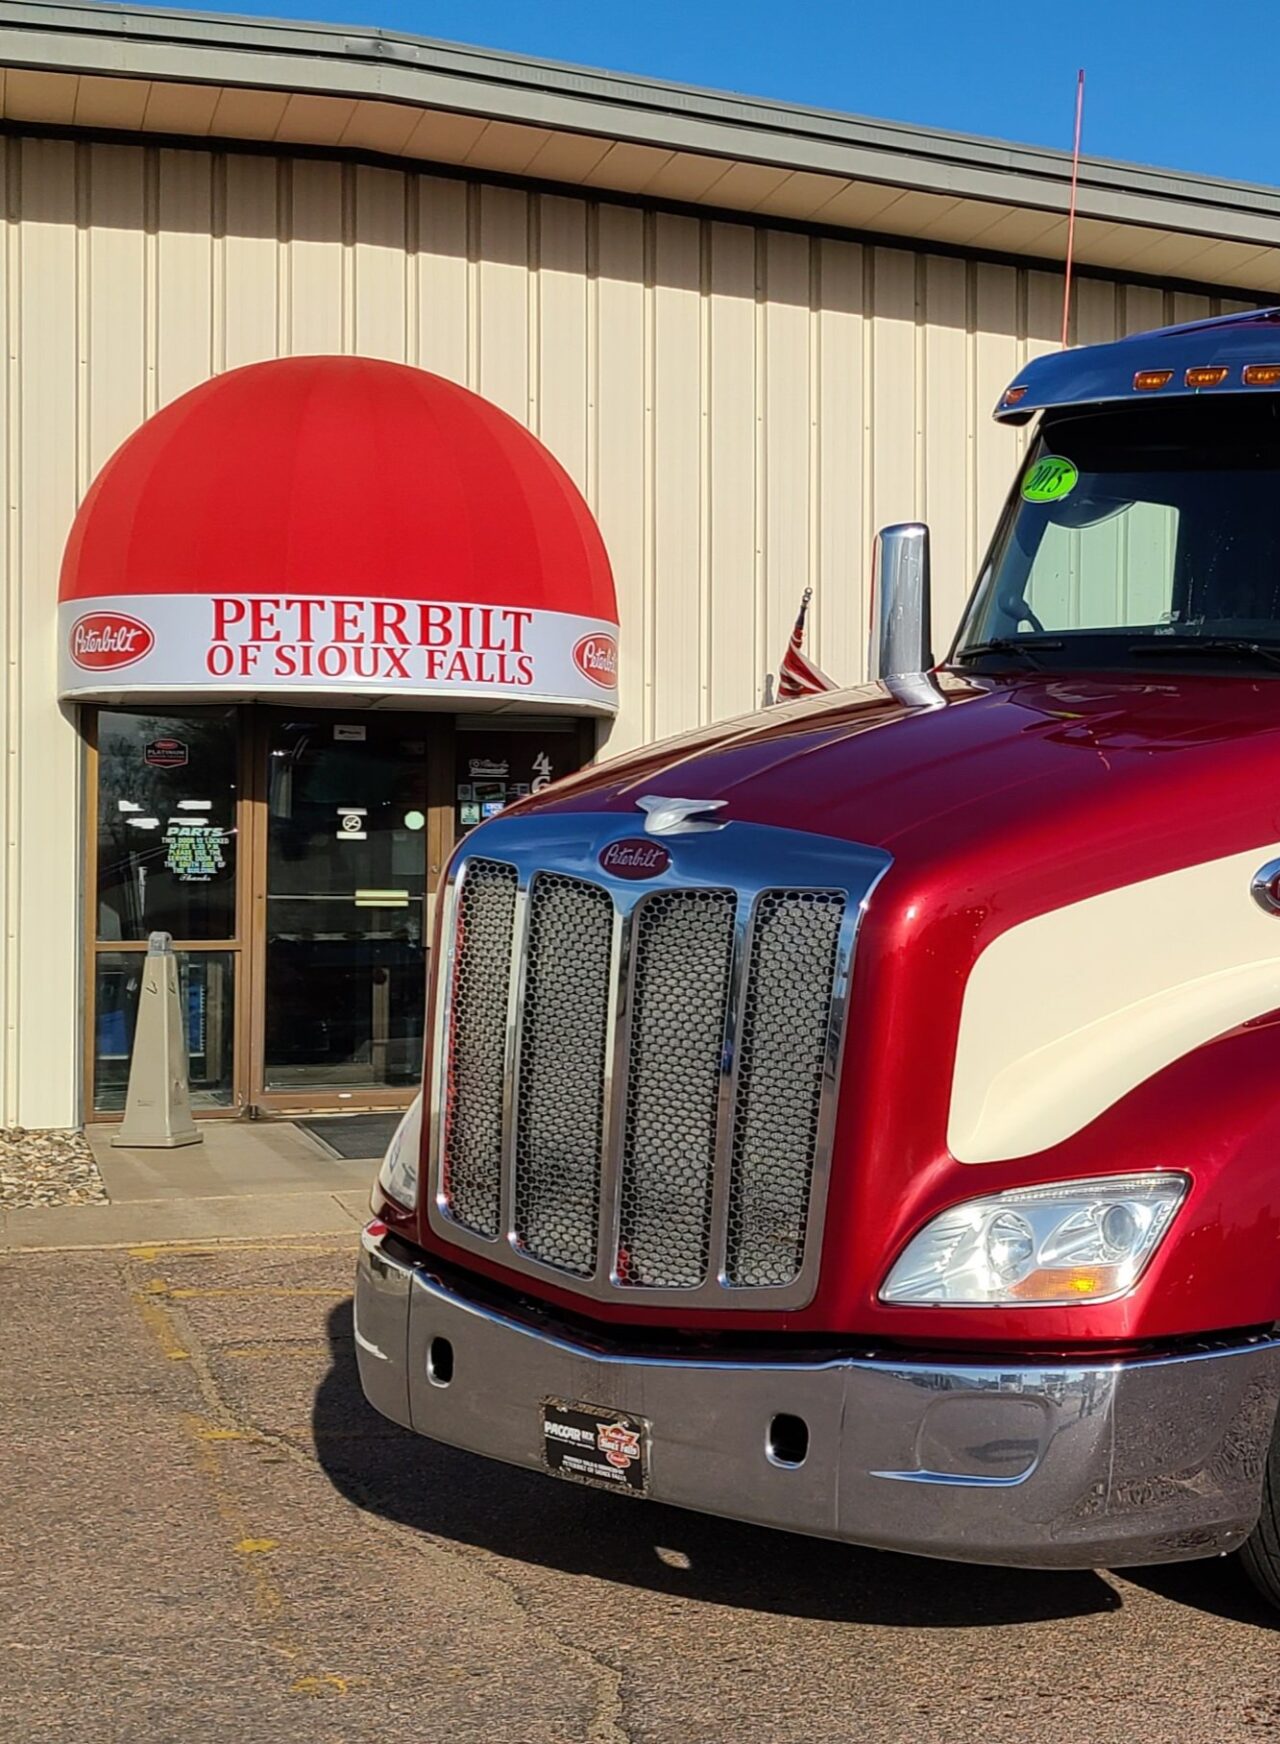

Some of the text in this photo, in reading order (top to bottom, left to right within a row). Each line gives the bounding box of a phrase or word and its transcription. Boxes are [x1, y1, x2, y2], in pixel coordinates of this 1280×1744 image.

[1024, 465, 1072, 493] 2015
[211, 598, 533, 653] PETERBILT
[74, 624, 143, 657] Peterbilt
[206, 644, 534, 686] OF SIOUX FALLS
[166, 827, 224, 837] PARTS
[604, 843, 665, 868] Peterbilt
[544, 1420, 581, 1441] PACCAR
